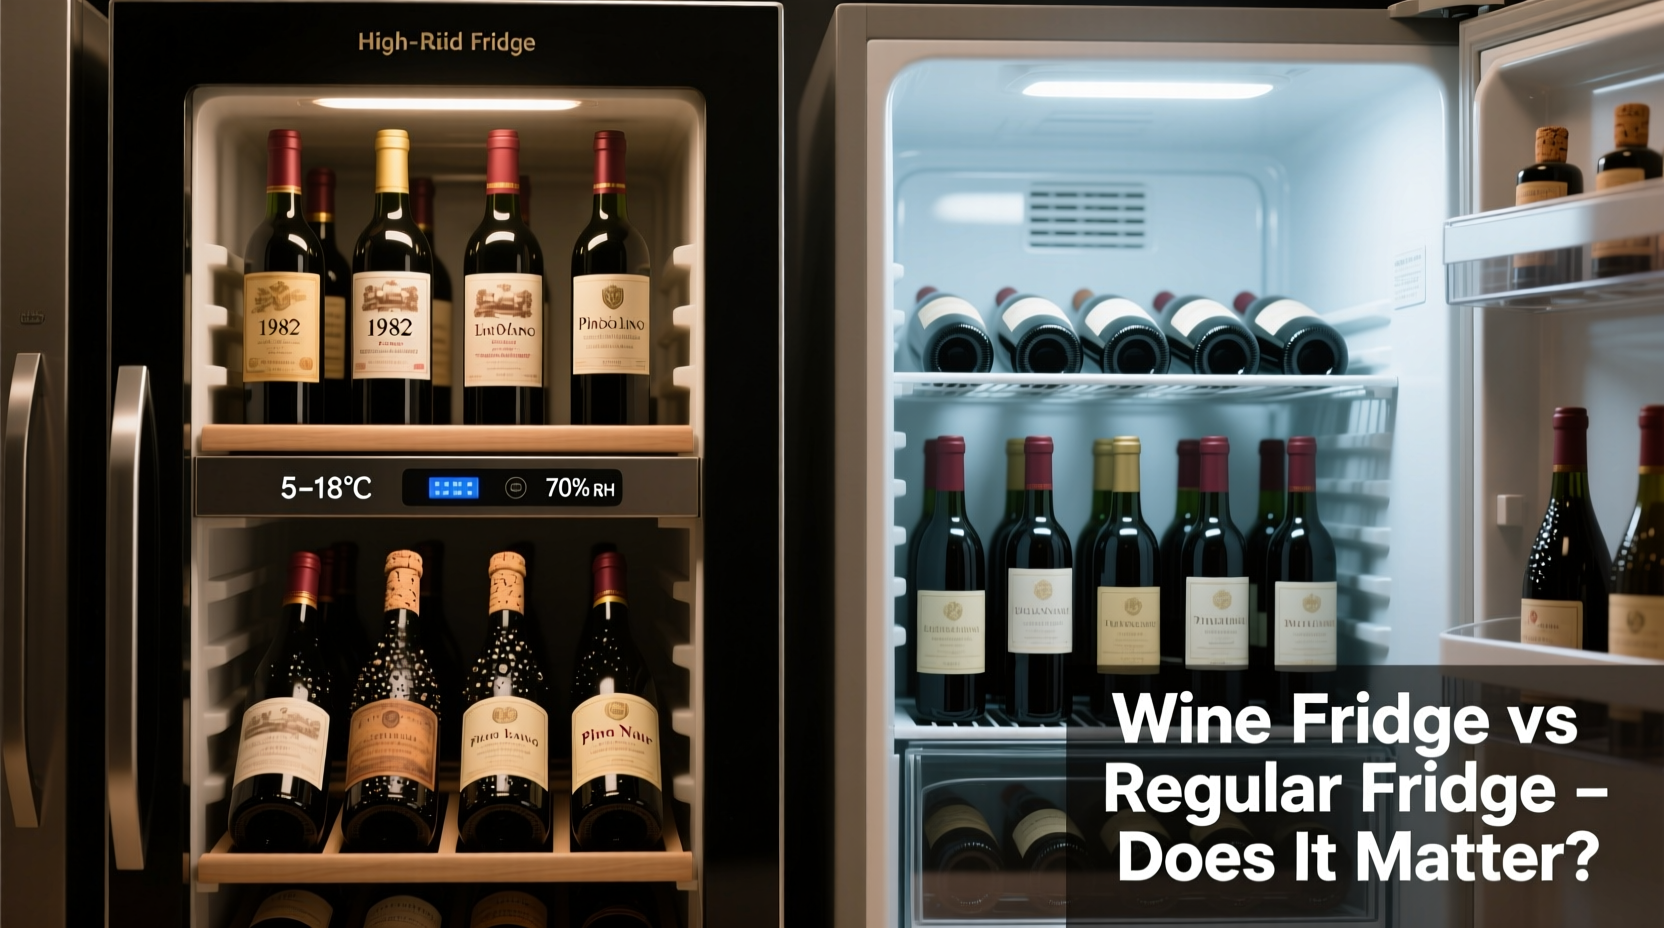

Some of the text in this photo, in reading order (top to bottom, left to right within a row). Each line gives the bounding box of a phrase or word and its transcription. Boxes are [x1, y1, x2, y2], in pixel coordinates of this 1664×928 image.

[471, 31, 536, 57] Fridge
[258, 318, 301, 336] 1982
[367, 317, 413, 337] 1982
[545, 477, 615, 498] 70% RH
